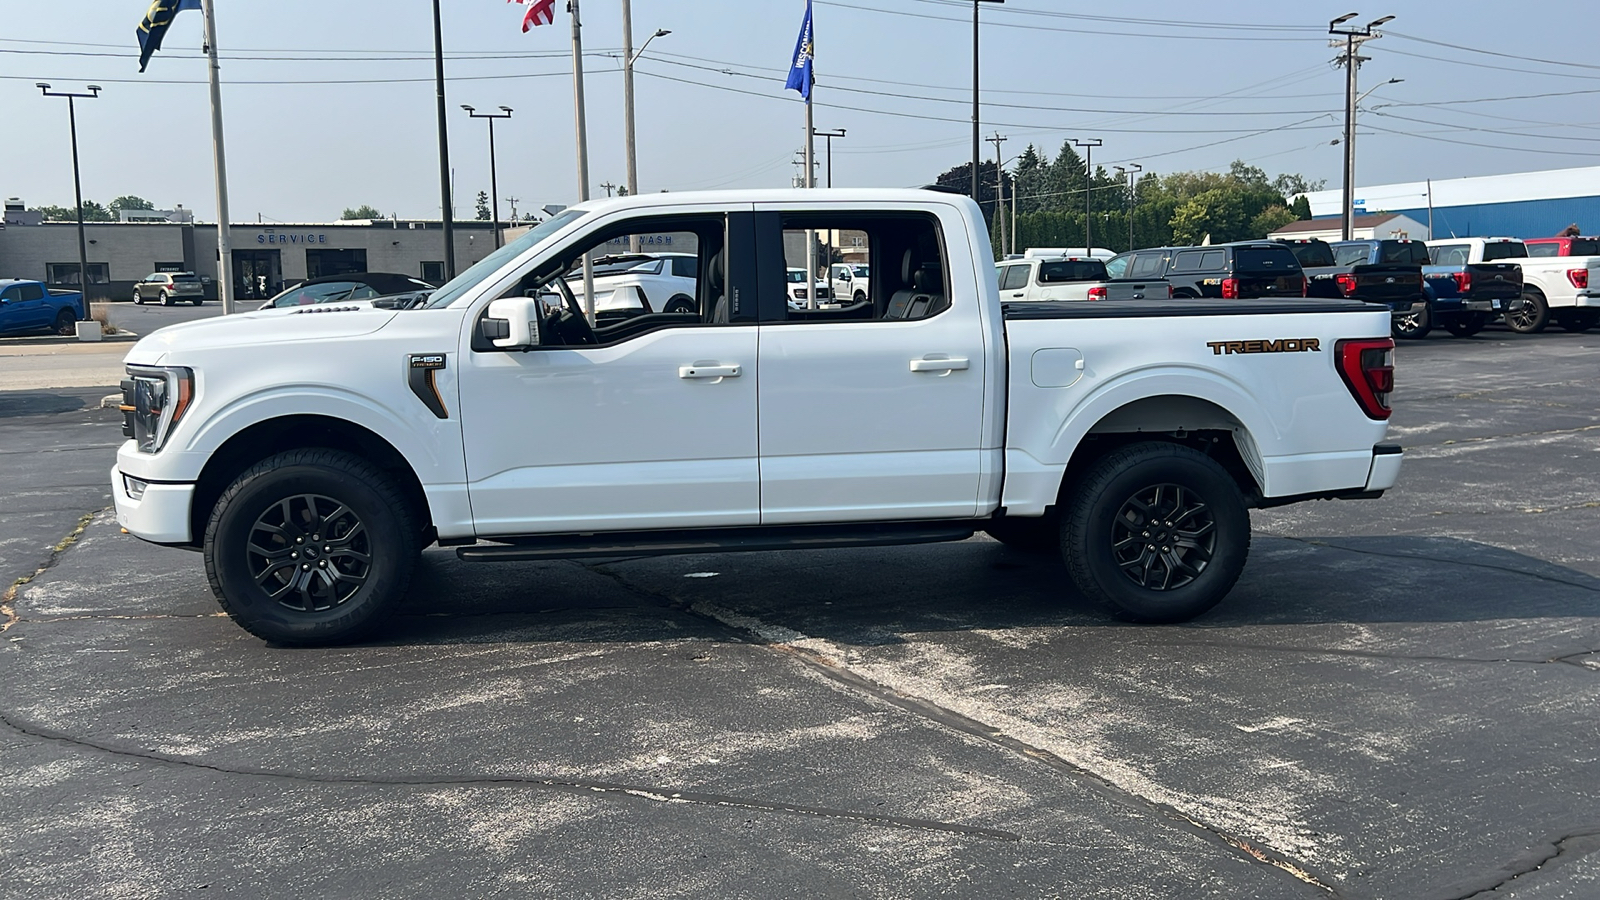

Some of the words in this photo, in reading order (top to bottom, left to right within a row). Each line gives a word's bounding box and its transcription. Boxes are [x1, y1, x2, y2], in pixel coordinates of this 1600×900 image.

[257, 234, 326, 243] SERVICE
[606, 235, 630, 245] AR
[639, 236, 672, 244] WASH
[1206, 338, 1321, 355] TREMOR
